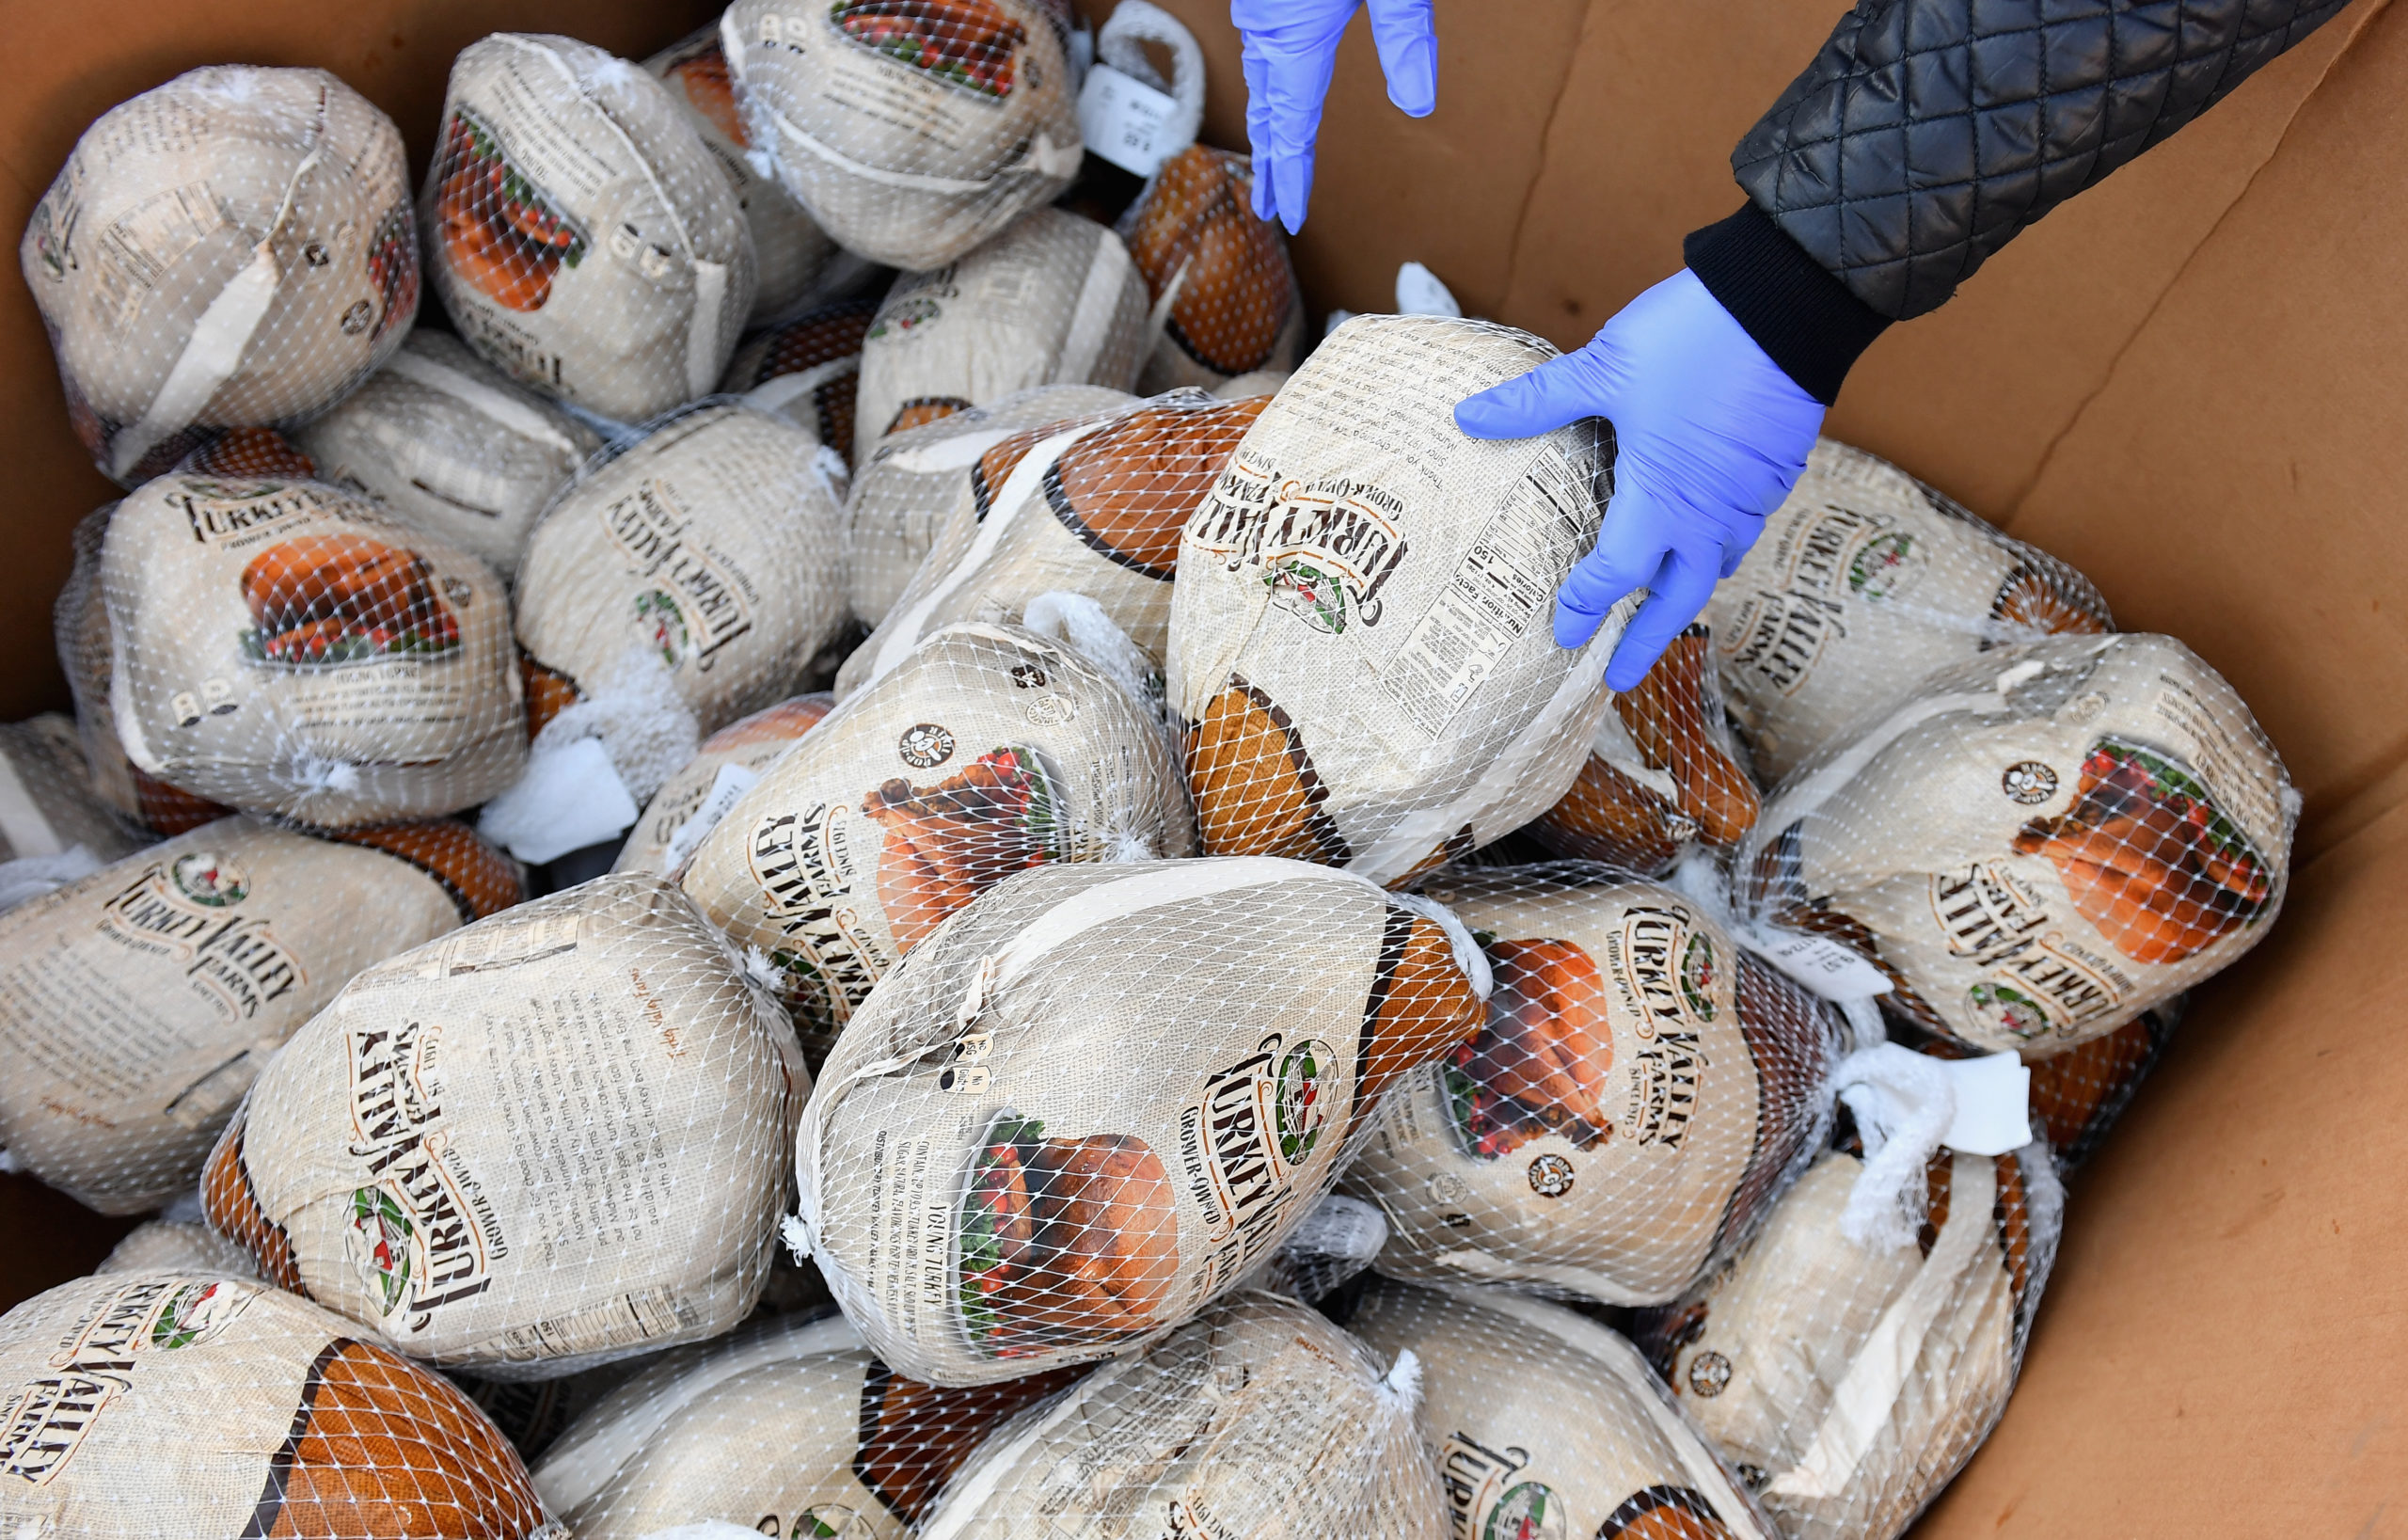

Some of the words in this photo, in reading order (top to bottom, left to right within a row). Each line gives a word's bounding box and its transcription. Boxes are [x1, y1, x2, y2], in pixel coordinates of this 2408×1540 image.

[1472, 545, 1496, 564] 150
[1735, 594, 1785, 661] FARMS
[1757, 590, 1844, 687] VALLEY
[755, 813, 832, 932] VALLEY
[802, 800, 851, 897] FARMS
[835, 841, 857, 875] SINCE
[198, 917, 295, 1001] VALLEY
[1623, 905, 1690, 1025] TURKEY
[349, 1031, 423, 1174] VALLEY
[1203, 1032, 1283, 1211] TURKEY
[1635, 1050, 1664, 1146] FARMS
[1655, 1032, 1708, 1148] VALLEY
[1179, 1105, 1222, 1225] GROWER-OWNED
[394, 1161, 491, 1331] TURKEY
[926, 1204, 945, 1253] YOUNG
[86, 1283, 168, 1356] RKEY
[924, 1257, 942, 1307] TURKEY
[6, 1360, 135, 1483] VALLEY
